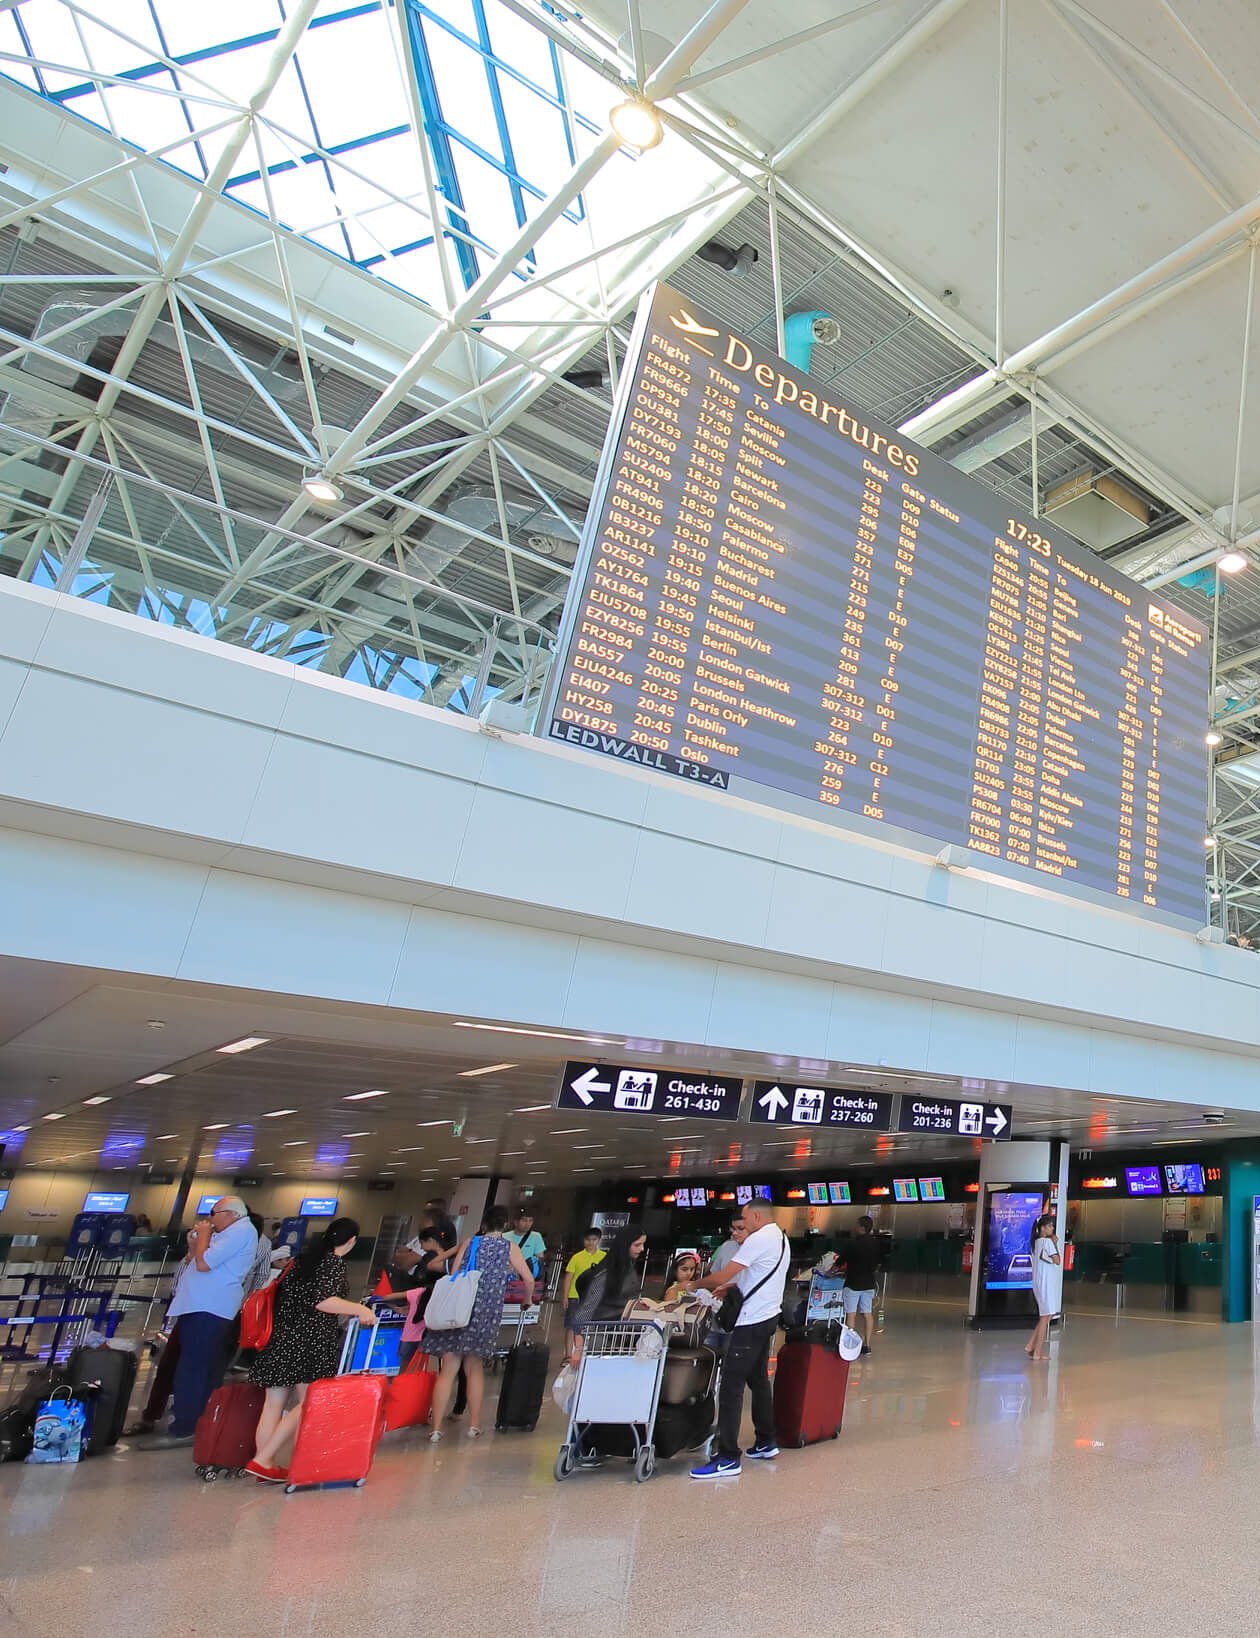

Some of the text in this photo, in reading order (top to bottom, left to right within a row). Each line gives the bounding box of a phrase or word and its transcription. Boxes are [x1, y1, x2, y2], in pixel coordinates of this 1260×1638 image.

[636, 393, 763, 469] OU381 18:00 Split
[643, 364, 779, 449] FR9666 17:45 Seville
[646, 351, 921, 515] FR4872 17:35 Catania 223 D09
[651, 334, 960, 524] Flight Time To Desk Gate Status
[722, 334, 919, 476] Departures
[622, 450, 775, 533] SU2409 18:20 Moscow
[626, 435, 759, 511] MS794 18:20 Cairo
[629, 421, 786, 510] FR7060 18:15 Barcelona
[633, 406, 914, 562] DY7193 18:05 Newark 357 E37
[639, 379, 917, 539] DP934 17:50 Moscow 295 E06
[608, 510, 759, 586] IB3237 19:10 Madrid
[611, 495, 775, 579] 0B1216 19:10 Bucharest
[615, 479, 768, 560] FR4906 18:50 Palermo
[618, 466, 785, 554] AT941 18:50 Casablanca
[596, 557, 755, 632] AY1764 19:45 Helsinki
[601, 541, 744, 611] OZ562 19:40 Seoul
[604, 526, 787, 615] AR1141 19:15 Buenos Aires
[1006, 519, 1051, 558] 17:23
[1056, 554, 1088, 582] Tuesday
[1099, 581, 1113, 596] Jun
[585, 605, 791, 694] EZY8256 19:55 London Gatwick
[593, 571, 772, 655] TK1864 19:50 Istanbul/Ist
[573, 655, 748, 728] EJU4246 20:25 Paris Orly
[577, 638, 796, 727] BA557 20:05 London Heathrow
[581, 621, 745, 692] FR2984 20:00 Brussels
[589, 588, 895, 720] EJU5708 19:55 Berlin 307-312 D01
[565, 689, 740, 757] HY258 20:45 Tashkent
[569, 672, 727, 736] EI407 20:45 Dublin
[551, 722, 726, 789] LEDWALL T3-A
[561, 707, 884, 819] DY1875 20:50 Oslo 359 D05
[1007, 837, 1030, 852] 07:20
[1008, 824, 1032, 839] 07:00
[1009, 811, 1032, 826] 06:40
[664, 1095, 720, 1112] 261-430
[668, 1080, 726, 1097] Check-in
[830, 1110, 873, 1123] 237-260
[832, 1096, 878, 1111] Check-in
[912, 1102, 953, 1116] Check-in
[913, 1115, 952, 1128] 201-236
[1207, 1168, 1221, 1181] 237
